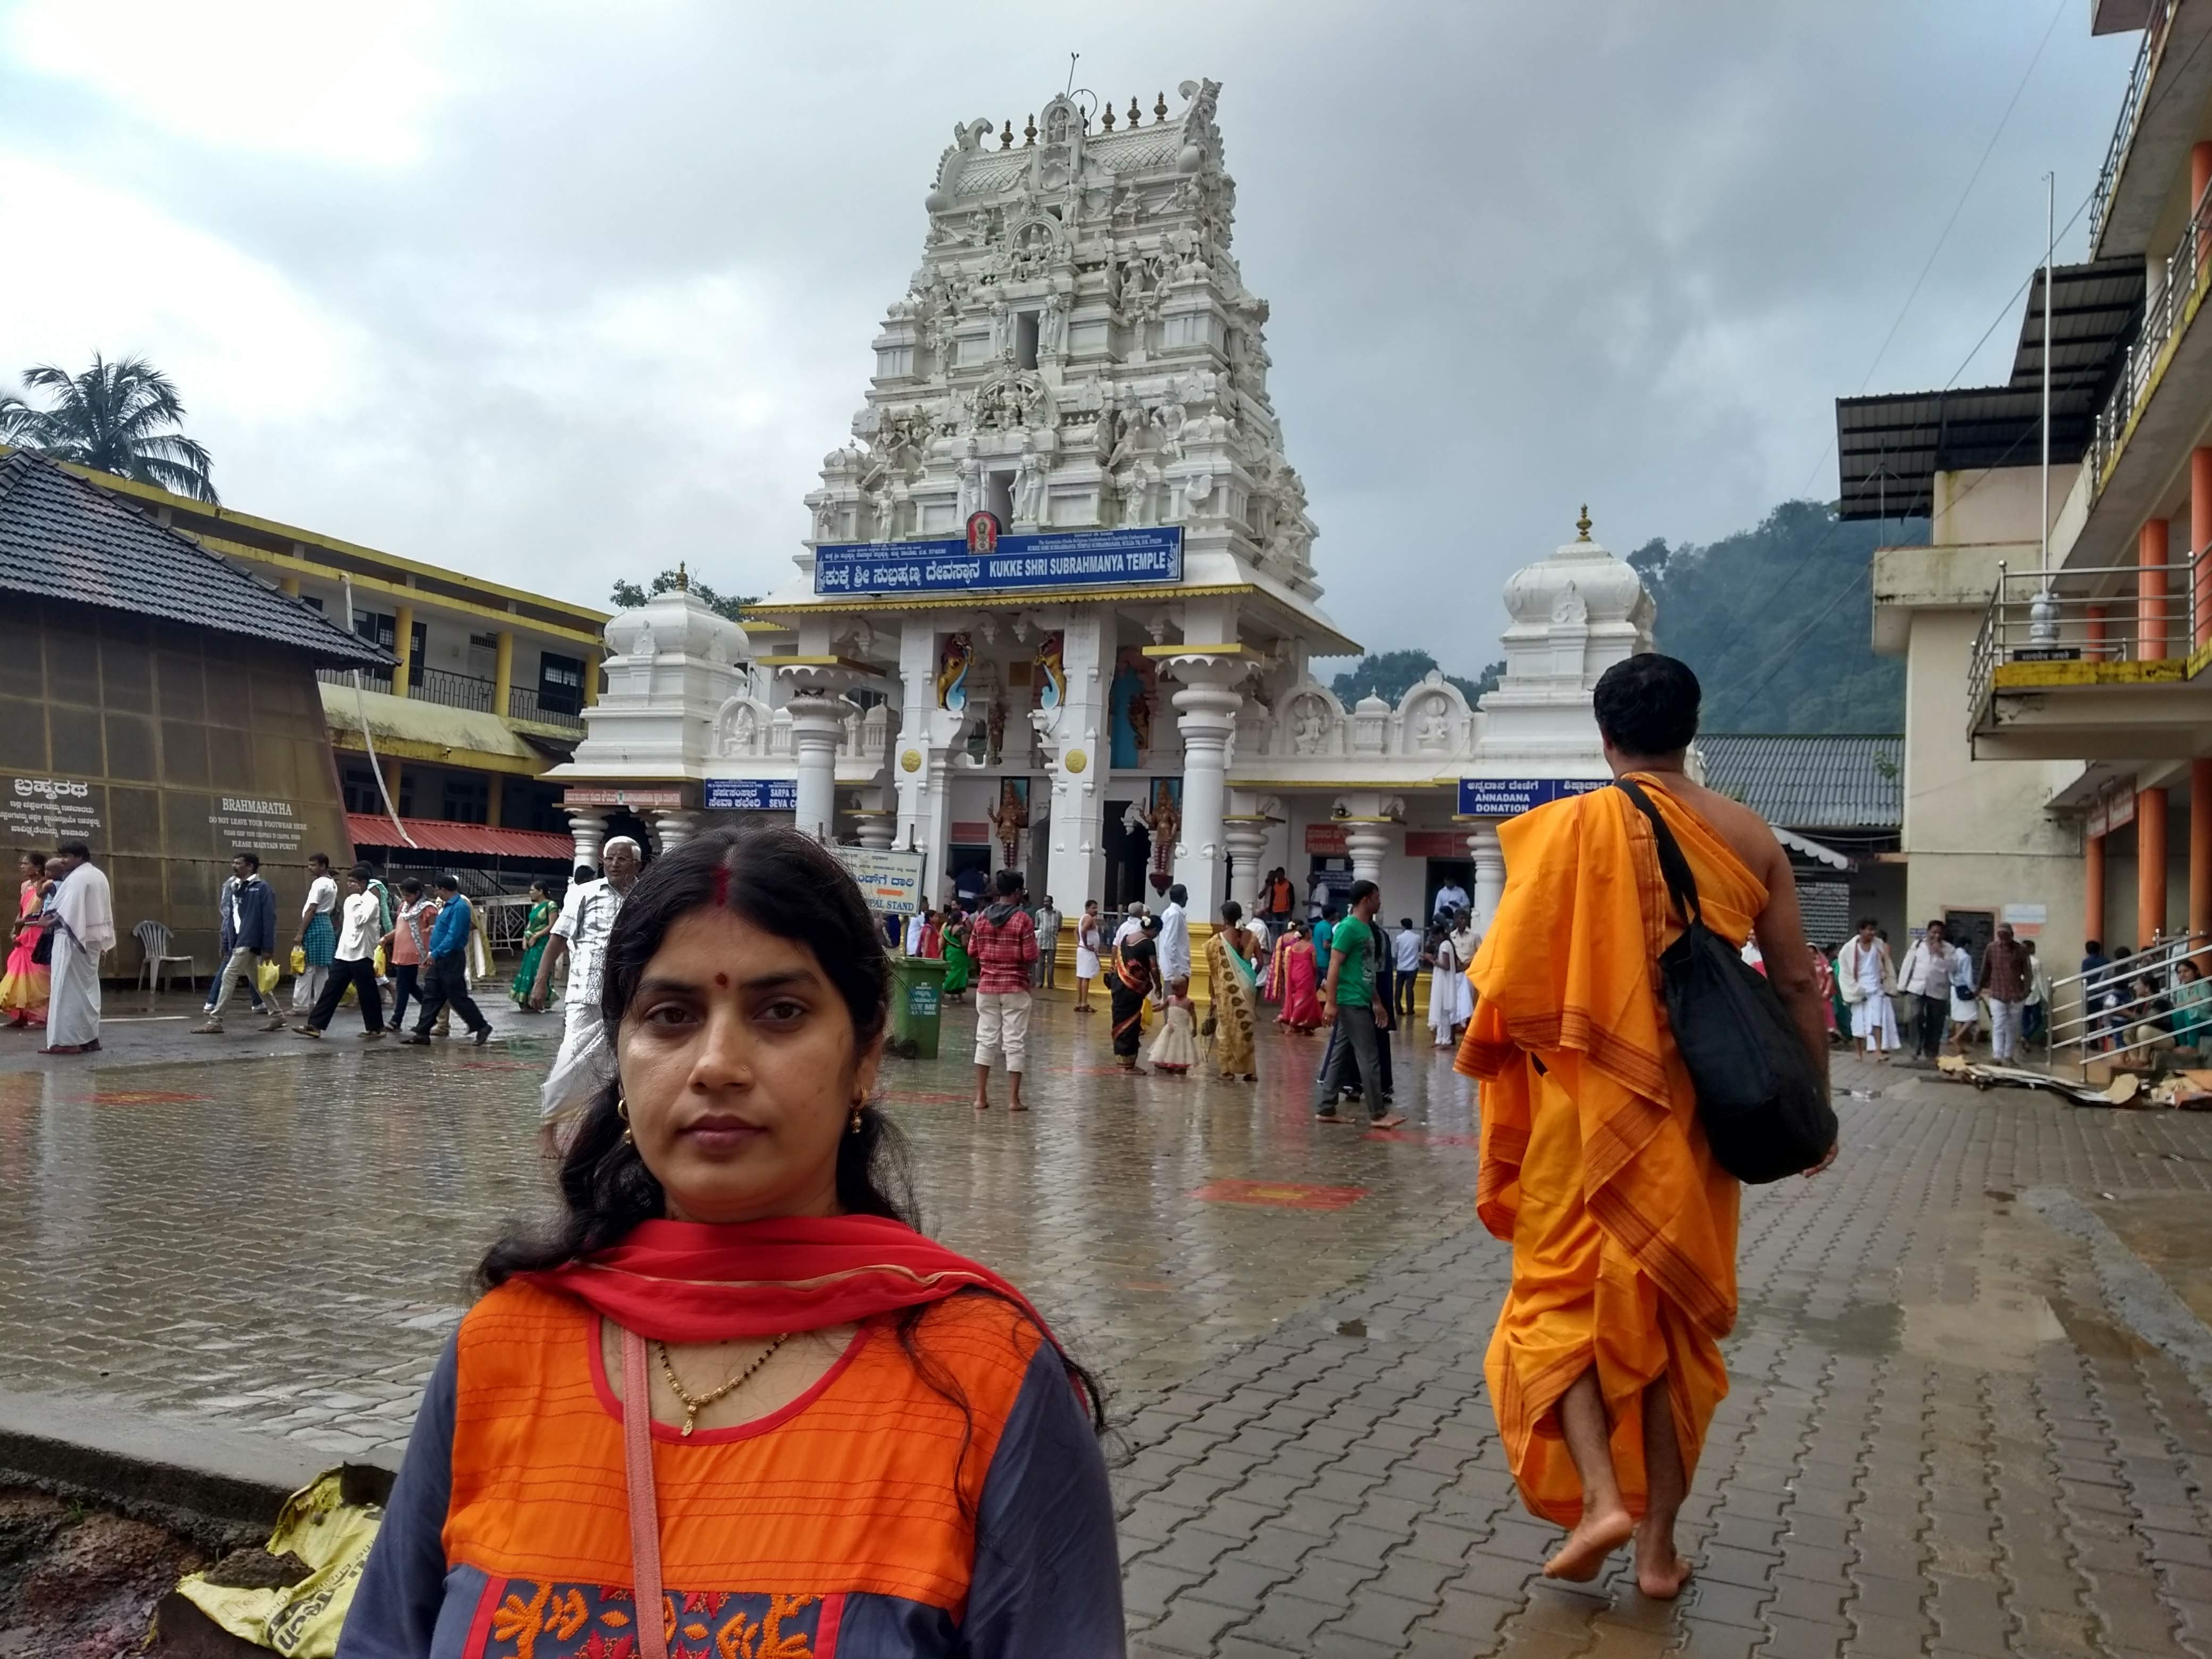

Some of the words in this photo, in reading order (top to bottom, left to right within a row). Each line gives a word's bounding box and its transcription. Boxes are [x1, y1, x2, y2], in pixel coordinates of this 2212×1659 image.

[990, 560, 1023, 577] KUKKE
[1025, 559, 1047, 576] SHRI
[1050, 555, 1124, 575] SUBRAHMANYA
[1127, 552, 1166, 571] TEMPLE
[824, 565, 850, 590] ಕುಕ್ಕೆ
[854, 565, 869, 587] ಶ್ರೀ
[14, 778, 88, 800] ಬ್ರಹ್ಮರಥ
[770, 789, 790, 797] SARPA
[1475, 793, 1530, 802] ANNADANA
[222, 798, 292, 816] BRAHMARATHA
[769, 799, 787, 808] SEVA
[1476, 803, 1529, 812] DONATION
[264, 820, 292, 829] FOOTWEAR
[891, 877, 914, 886] ದಾರಿ
[887, 901, 914, 911] STAND
